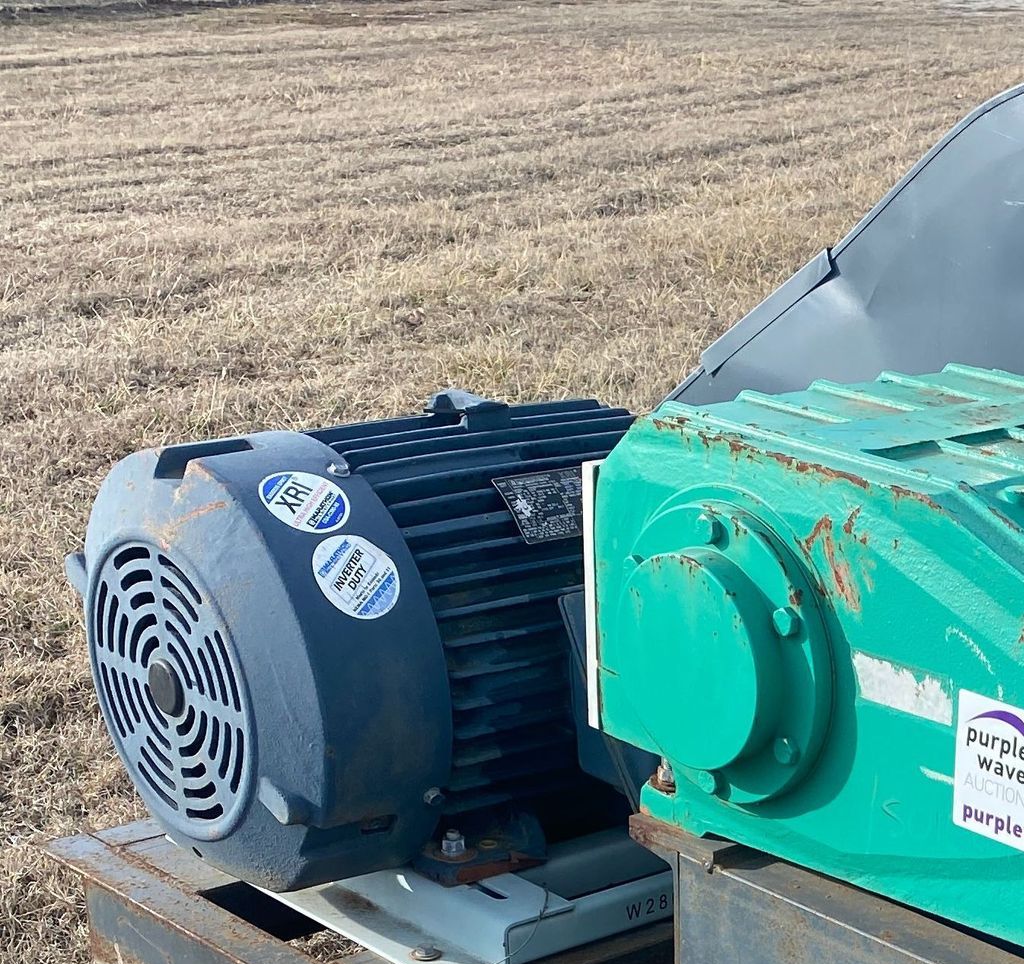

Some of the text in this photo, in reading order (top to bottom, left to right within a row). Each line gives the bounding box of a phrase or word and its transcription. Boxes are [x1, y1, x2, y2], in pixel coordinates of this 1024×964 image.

[275, 481, 313, 514] XRI
[334, 549, 364, 591] INVERTER
[348, 564, 367, 590] DUTY
[626, 894, 674, 920] W28
